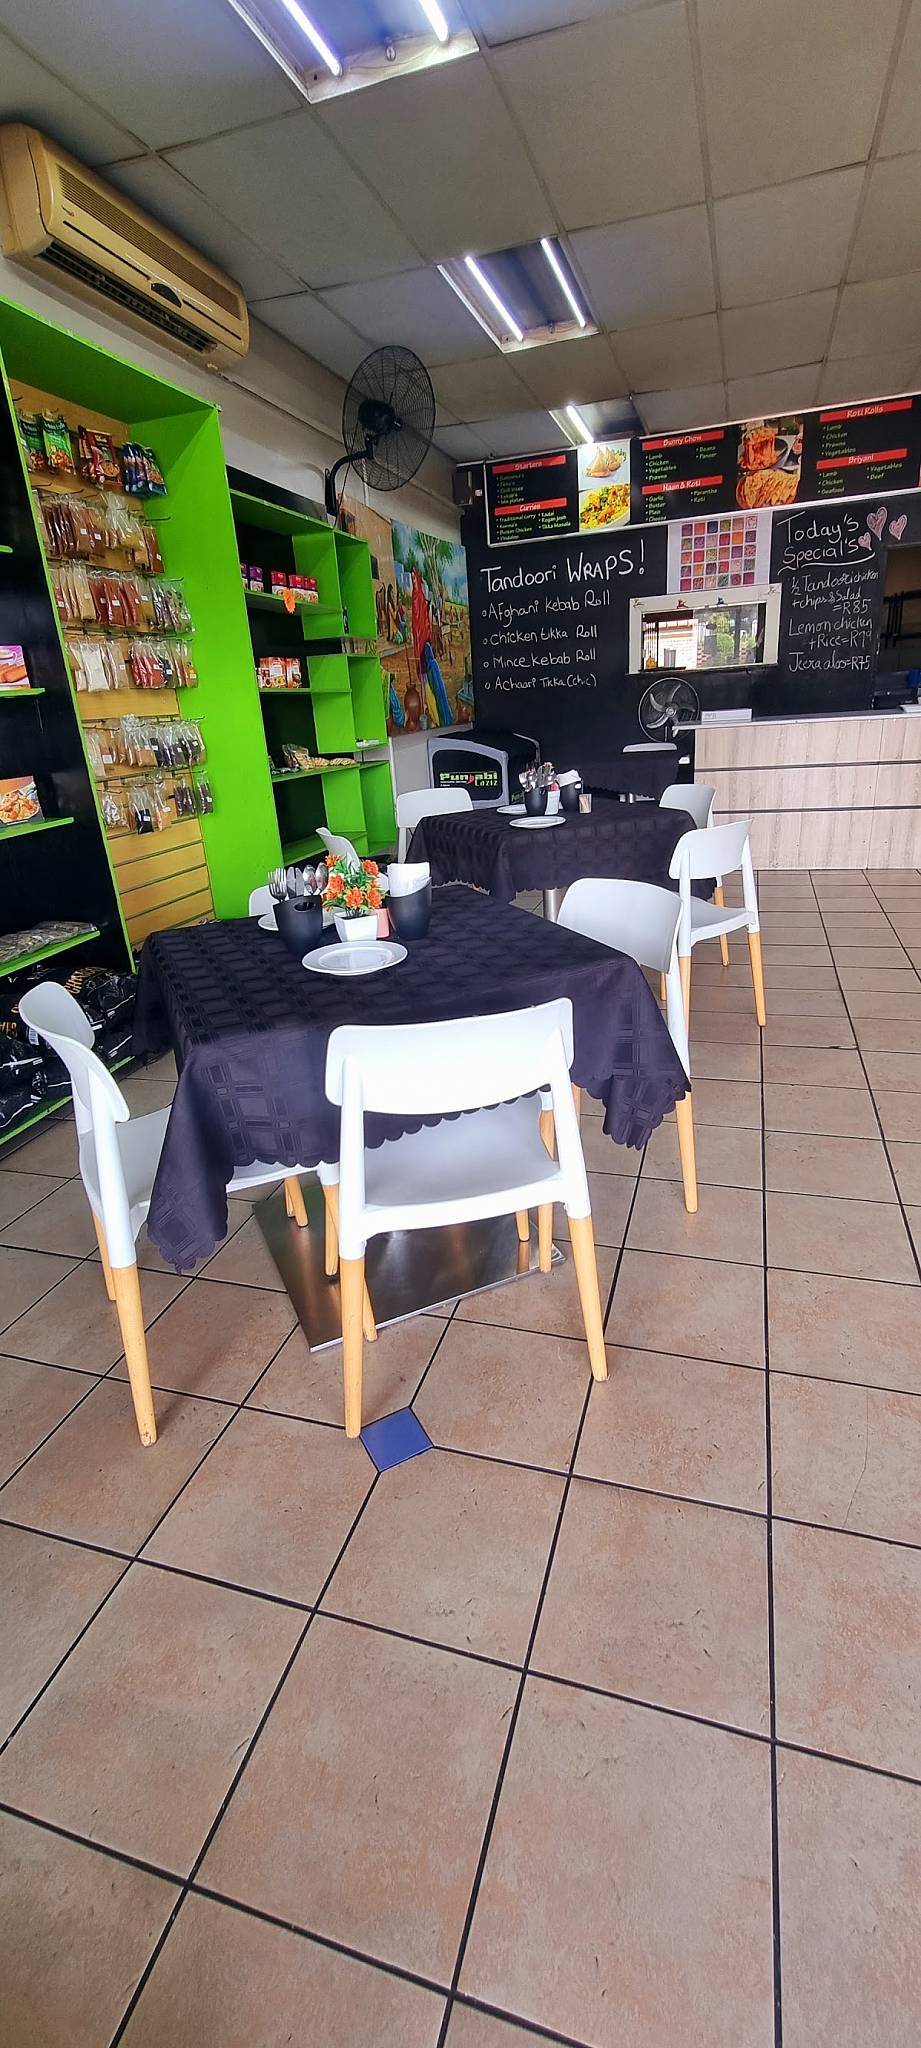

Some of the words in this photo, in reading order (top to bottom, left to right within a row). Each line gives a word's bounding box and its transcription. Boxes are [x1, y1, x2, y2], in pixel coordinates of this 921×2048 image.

[847, 409, 864, 418] Roti
[864, 406, 884, 415] Rolls
[684, 435, 702, 443] Chow
[825, 432, 848, 440] Chicken
[515, 461, 542, 470] Starters
[649, 466, 677, 474] Vegetables
[686, 480, 701, 488] Roti
[520, 504, 541, 512] Curries
[776, 511, 860, 544] Today's
[782, 538, 859, 568] Special's
[480, 564, 557, 593] Tandoori
[584, 589, 610, 607] Roll
[836, 586, 861, 602] Salad
[576, 624, 598, 639] Roll
[789, 618, 831, 637] Lemon
[834, 616, 873, 630] chicken
[493, 655, 531, 669] Mince
[576, 647, 596, 662] Roll
